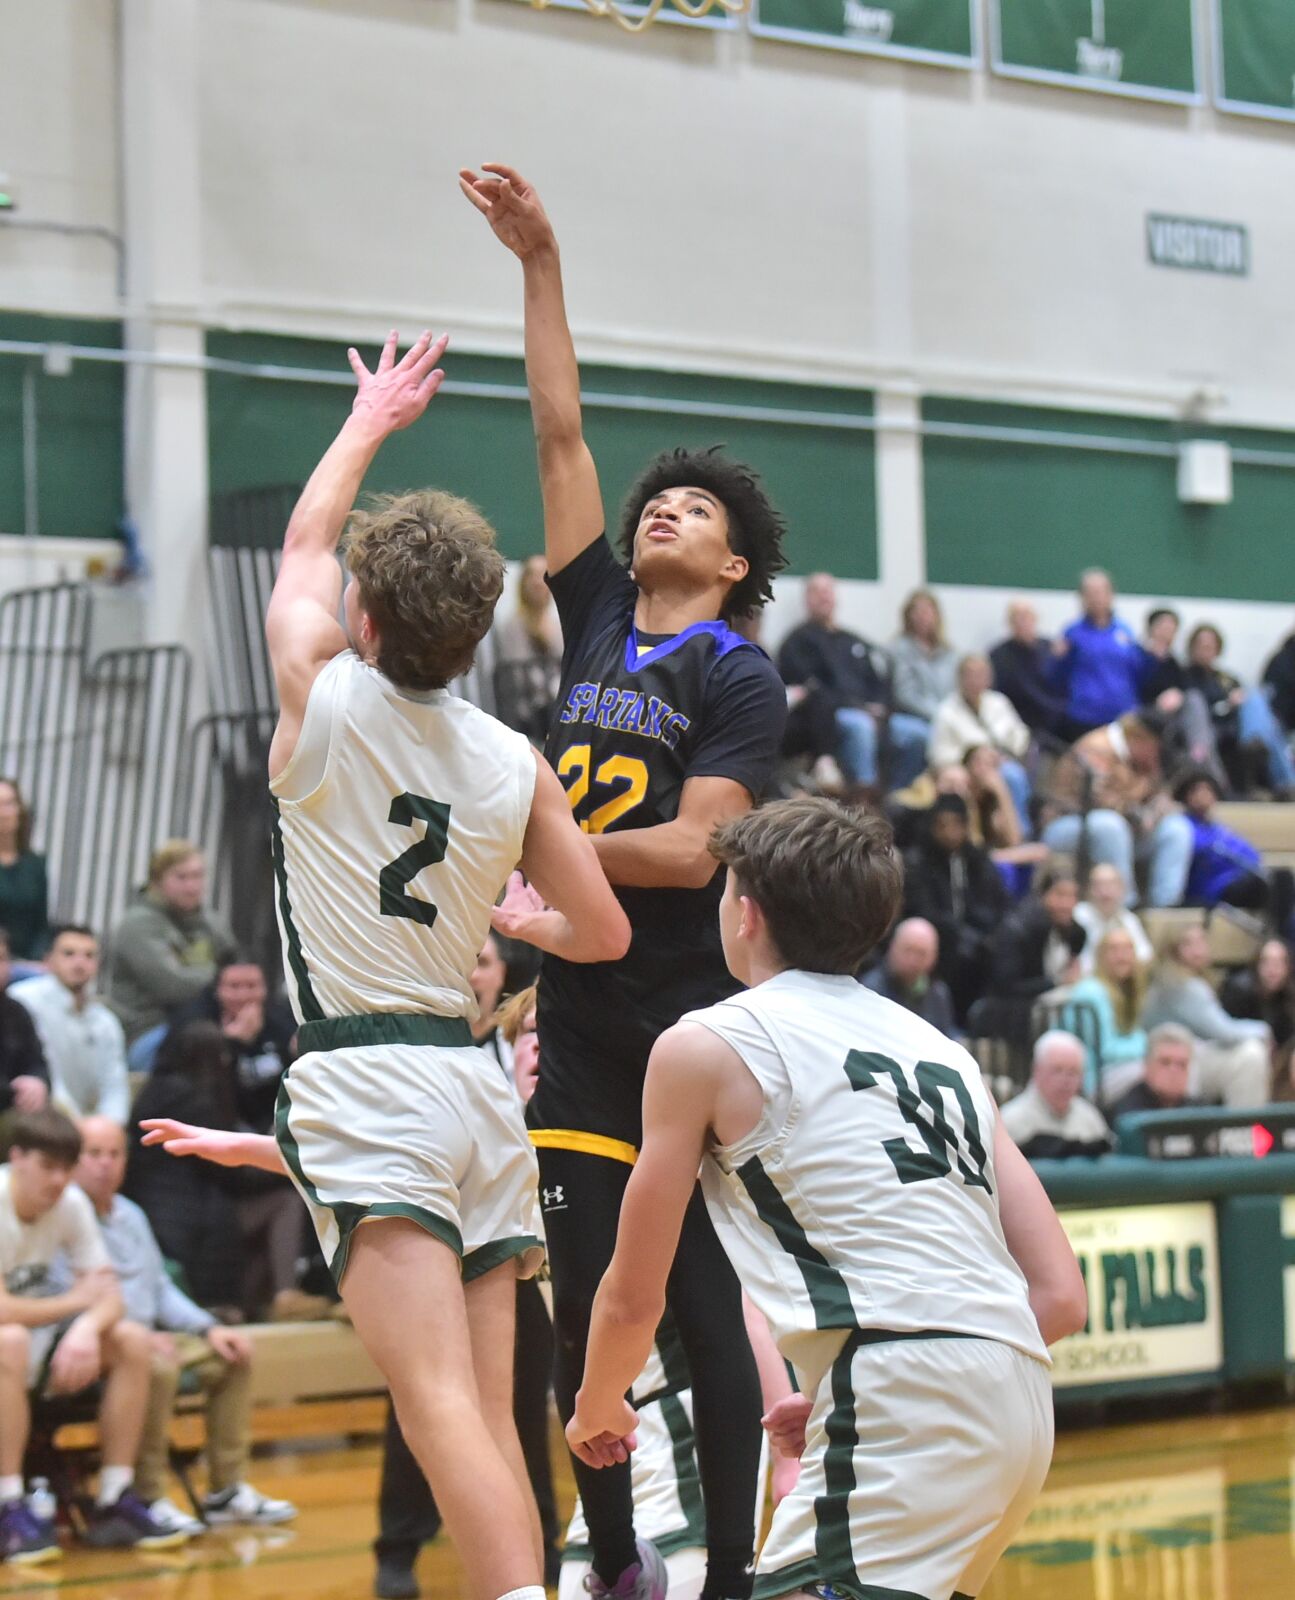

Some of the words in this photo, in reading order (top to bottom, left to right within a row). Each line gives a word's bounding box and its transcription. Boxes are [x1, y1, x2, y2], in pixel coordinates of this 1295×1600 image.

[1150, 222, 1243, 269] VISITOR
[560, 681, 692, 751] SPARTANS
[557, 742, 649, 835] 22
[379, 791, 452, 929] 2
[842, 1048, 993, 1195] 30
